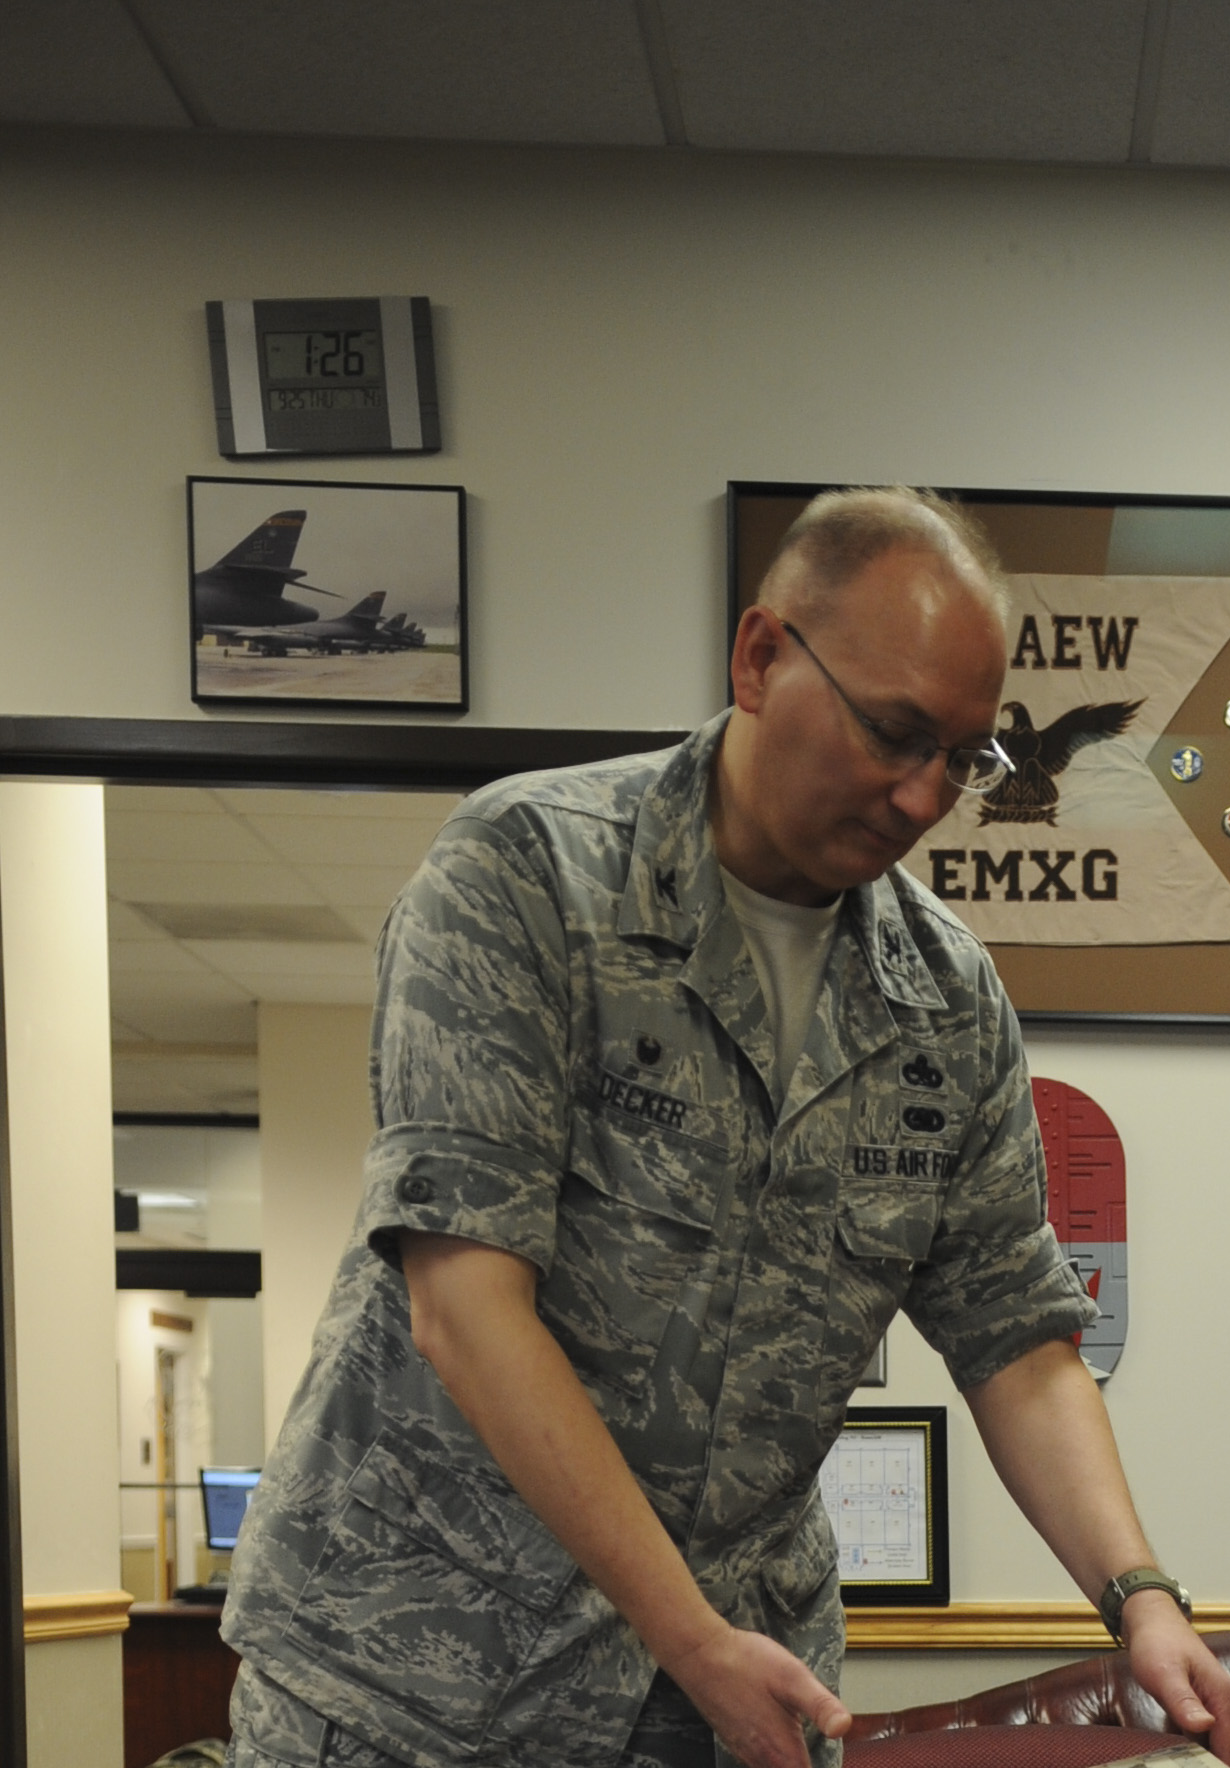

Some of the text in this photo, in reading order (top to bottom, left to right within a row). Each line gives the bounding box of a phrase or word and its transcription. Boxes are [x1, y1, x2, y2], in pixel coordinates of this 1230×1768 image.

[305, 331, 364, 377] 1:26
[1010, 614, 1139, 671] AEW
[928, 848, 1119, 902] EMXG
[601, 1075, 687, 1128] DECKER
[853, 1147, 891, 1175] U.S.
[896, 1151, 929, 1178] AIR
